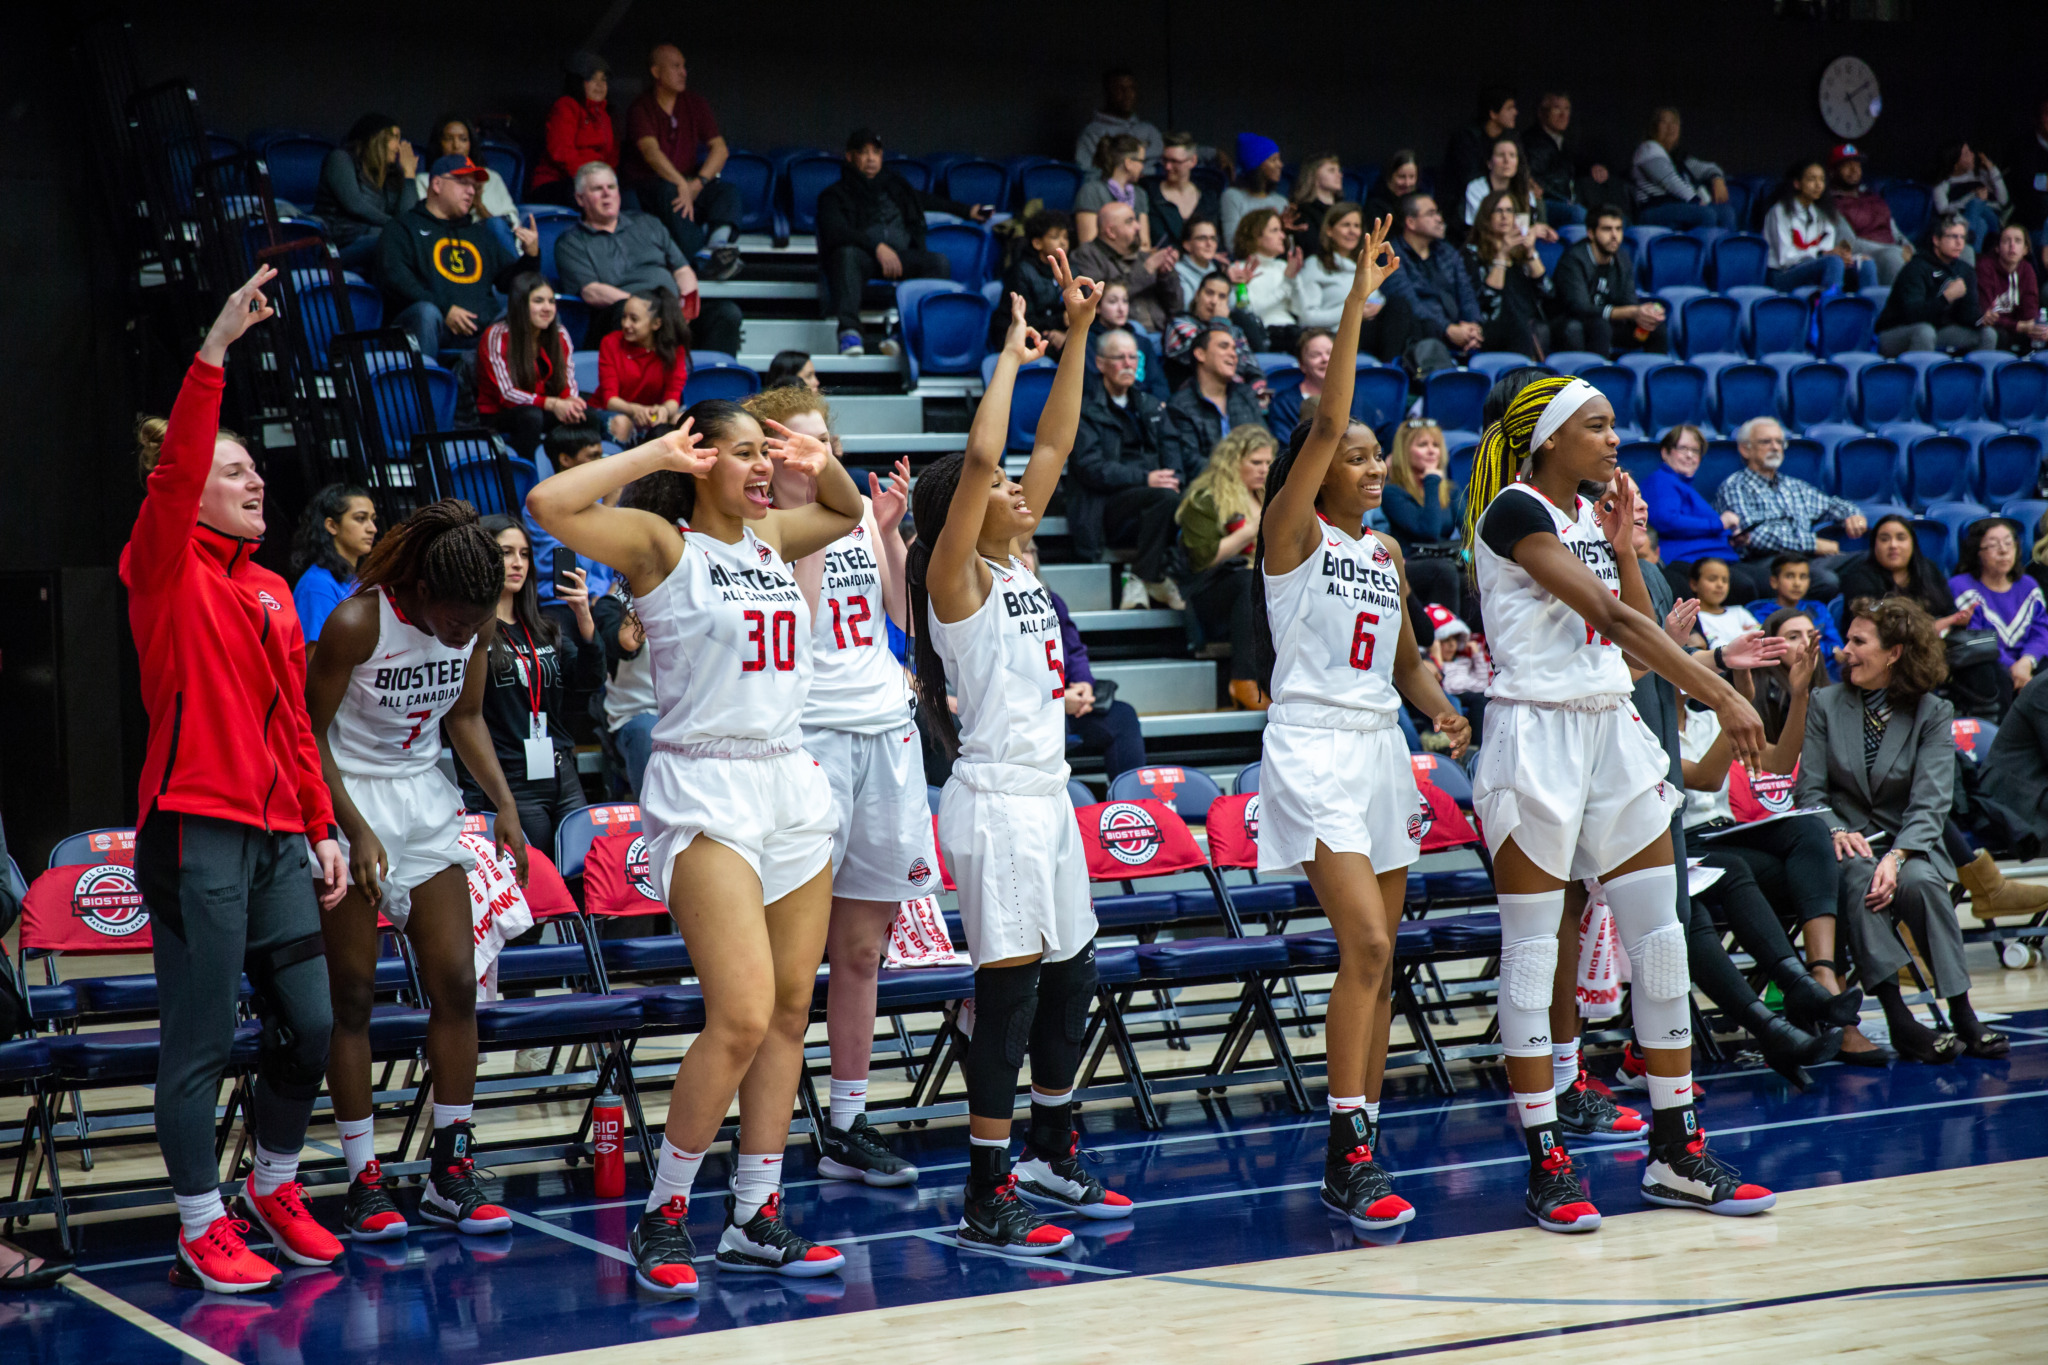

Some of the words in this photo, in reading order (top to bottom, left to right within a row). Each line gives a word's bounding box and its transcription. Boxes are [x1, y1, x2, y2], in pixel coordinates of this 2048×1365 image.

[823, 547, 877, 574] STEEL
[828, 573, 876, 589] CANADIAN
[723, 591, 745, 602] ALL
[744, 591, 801, 602] CANADIAN
[1326, 582, 1349, 598] ALL
[1353, 588, 1400, 612] CANADIAN
[828, 595, 873, 650] 12
[1020, 619, 1038, 634] ALL
[742, 610, 796, 672] 30
[1349, 611, 1380, 671] 6
[1045, 638, 1066, 700] 5
[378, 695, 402, 708] ALL
[406, 685, 461, 706] CANADIAN
[402, 709, 432, 749] 7
[1106, 828, 1154, 840] BIOSTEEL
[631, 842, 642, 855] ALL
[82, 872, 95, 886] ALL
[96, 866, 135, 878] CANADI
[88, 916, 130, 935] BASKETBALL
[130, 914, 146, 930] GAME
[593, 1120, 619, 1134] BIO
